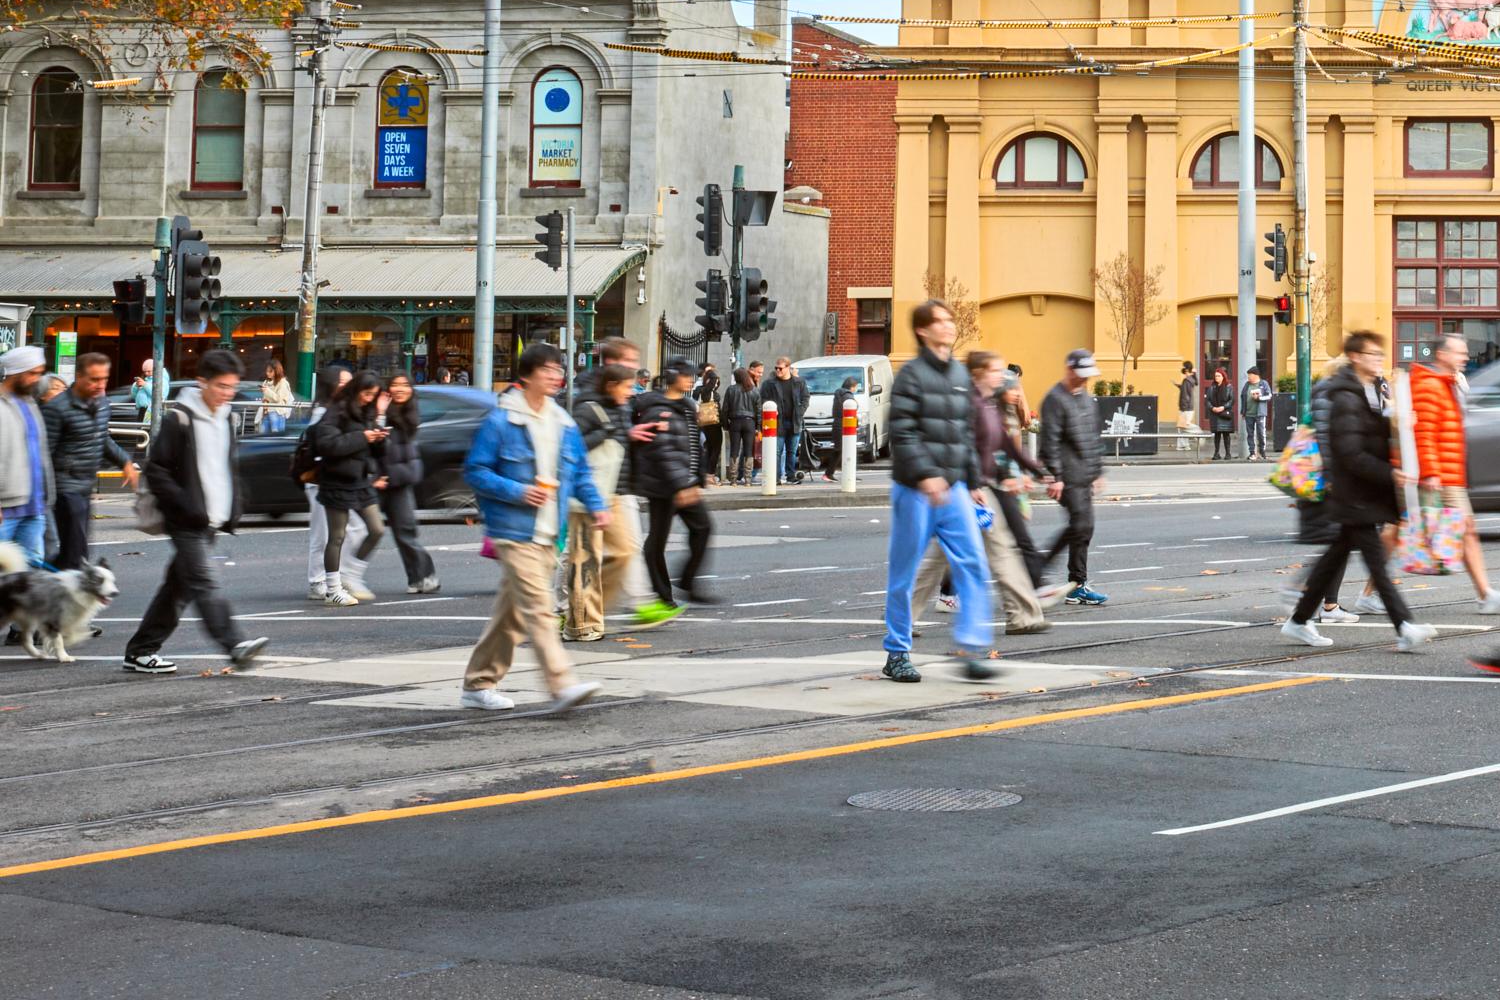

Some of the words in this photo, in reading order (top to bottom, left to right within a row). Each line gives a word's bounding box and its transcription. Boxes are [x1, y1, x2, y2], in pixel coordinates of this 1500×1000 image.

[1406, 80, 1451, 91] QUEEN
[385, 132, 406, 142] OPEN
[384, 144, 410, 153] SEVEN
[541, 149, 572, 158] MARKET
[384, 155, 406, 165] DAYS
[538, 158, 579, 167] PHARMACY
[383, 166, 390, 176] A
[391, 166, 414, 176] WEEK
